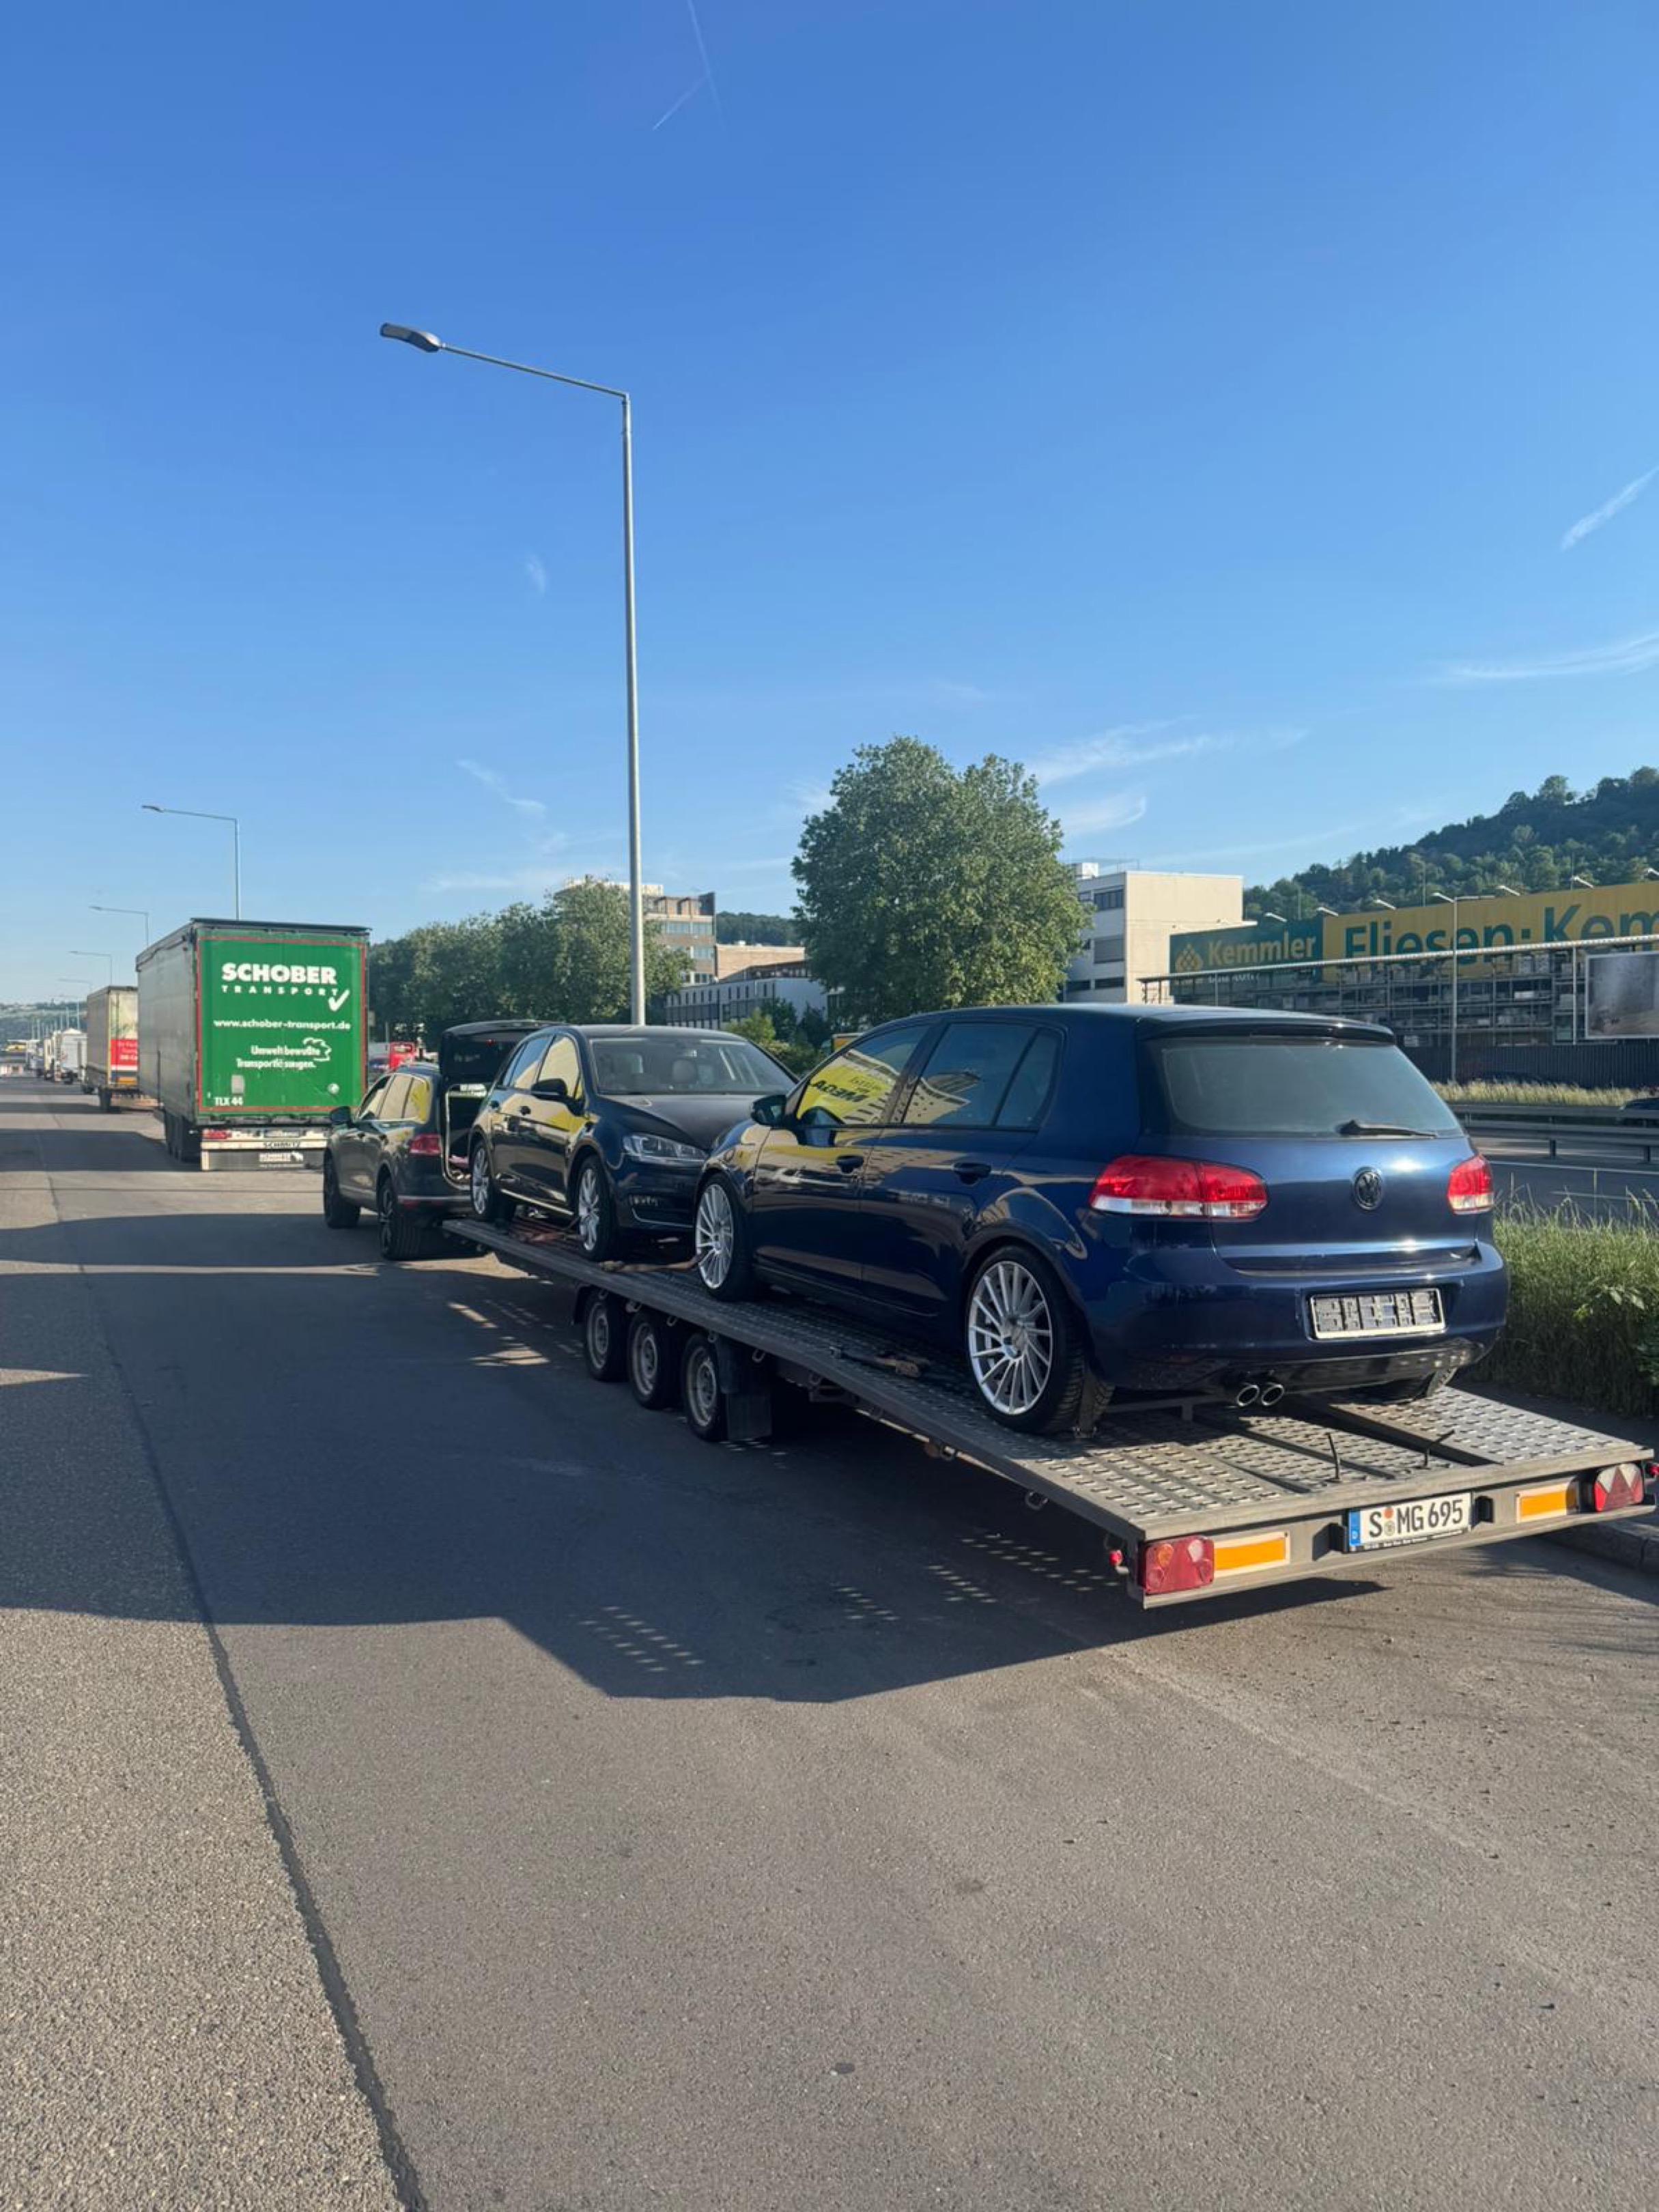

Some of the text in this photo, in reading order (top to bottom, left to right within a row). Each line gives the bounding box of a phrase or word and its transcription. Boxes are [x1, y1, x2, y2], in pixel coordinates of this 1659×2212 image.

[1207, 931, 1316, 966] Kemmler
[221, 962, 337, 984] SCHOBER
[221, 985, 339, 996] TRANSPORT
[213, 1019, 351, 1031] www.schober-transport.de
[1369, 1511, 1382, 1537] S
[1397, 1505, 1424, 1534] MG
[1428, 1499, 1463, 1528] 695
